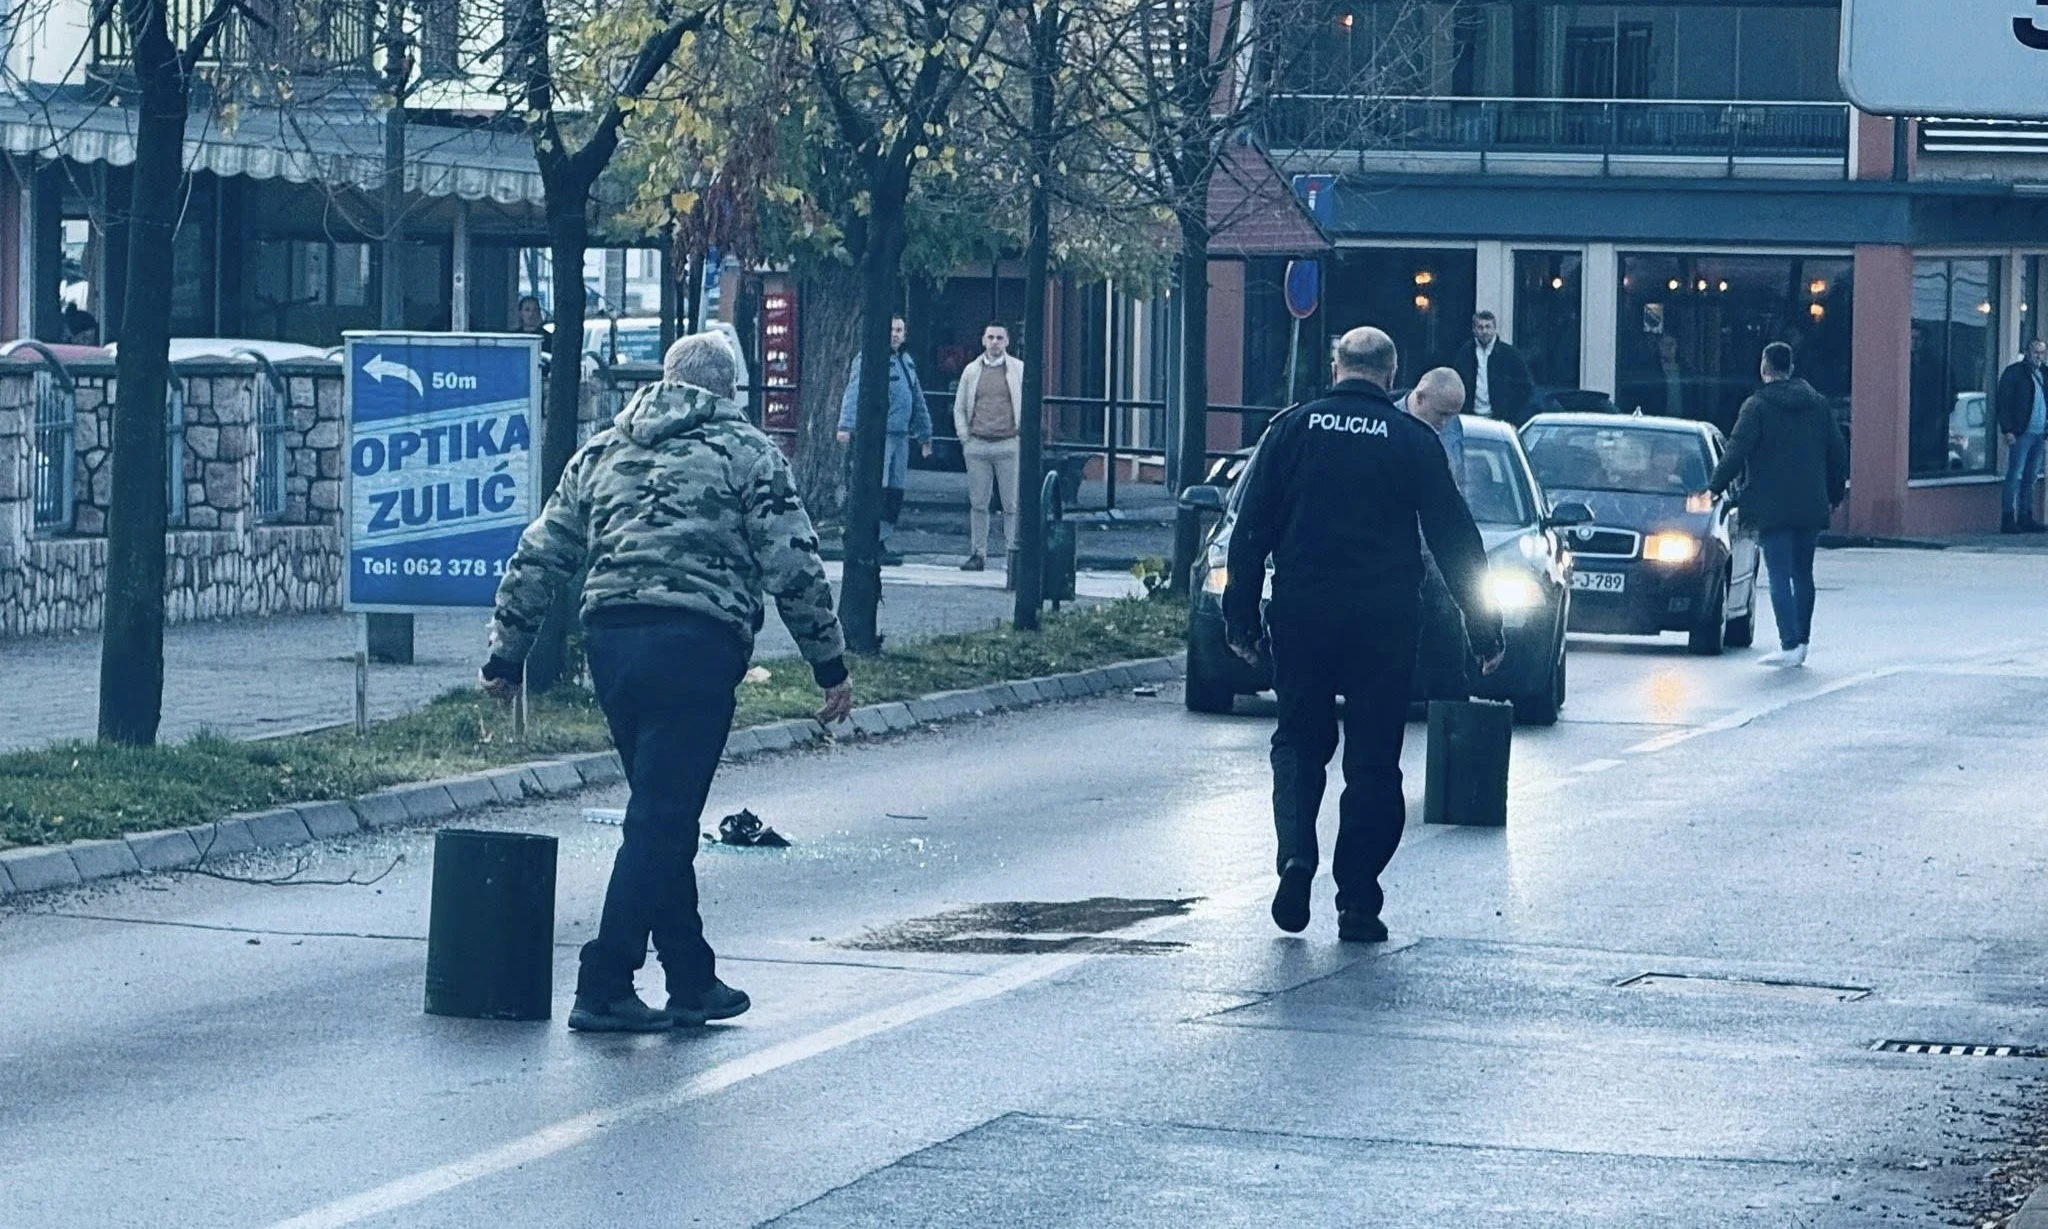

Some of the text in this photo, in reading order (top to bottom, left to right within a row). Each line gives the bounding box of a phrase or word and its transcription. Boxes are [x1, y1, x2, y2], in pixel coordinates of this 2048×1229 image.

[432, 372, 477, 390] 50m
[1308, 413, 1388, 438] POLICIJA
[351, 414, 530, 477] OPTIKA
[367, 461, 516, 533] ZULIĆ
[362, 557, 506, 576] Tel: 062 378 1
[1574, 573, 1622, 589] -J-789
